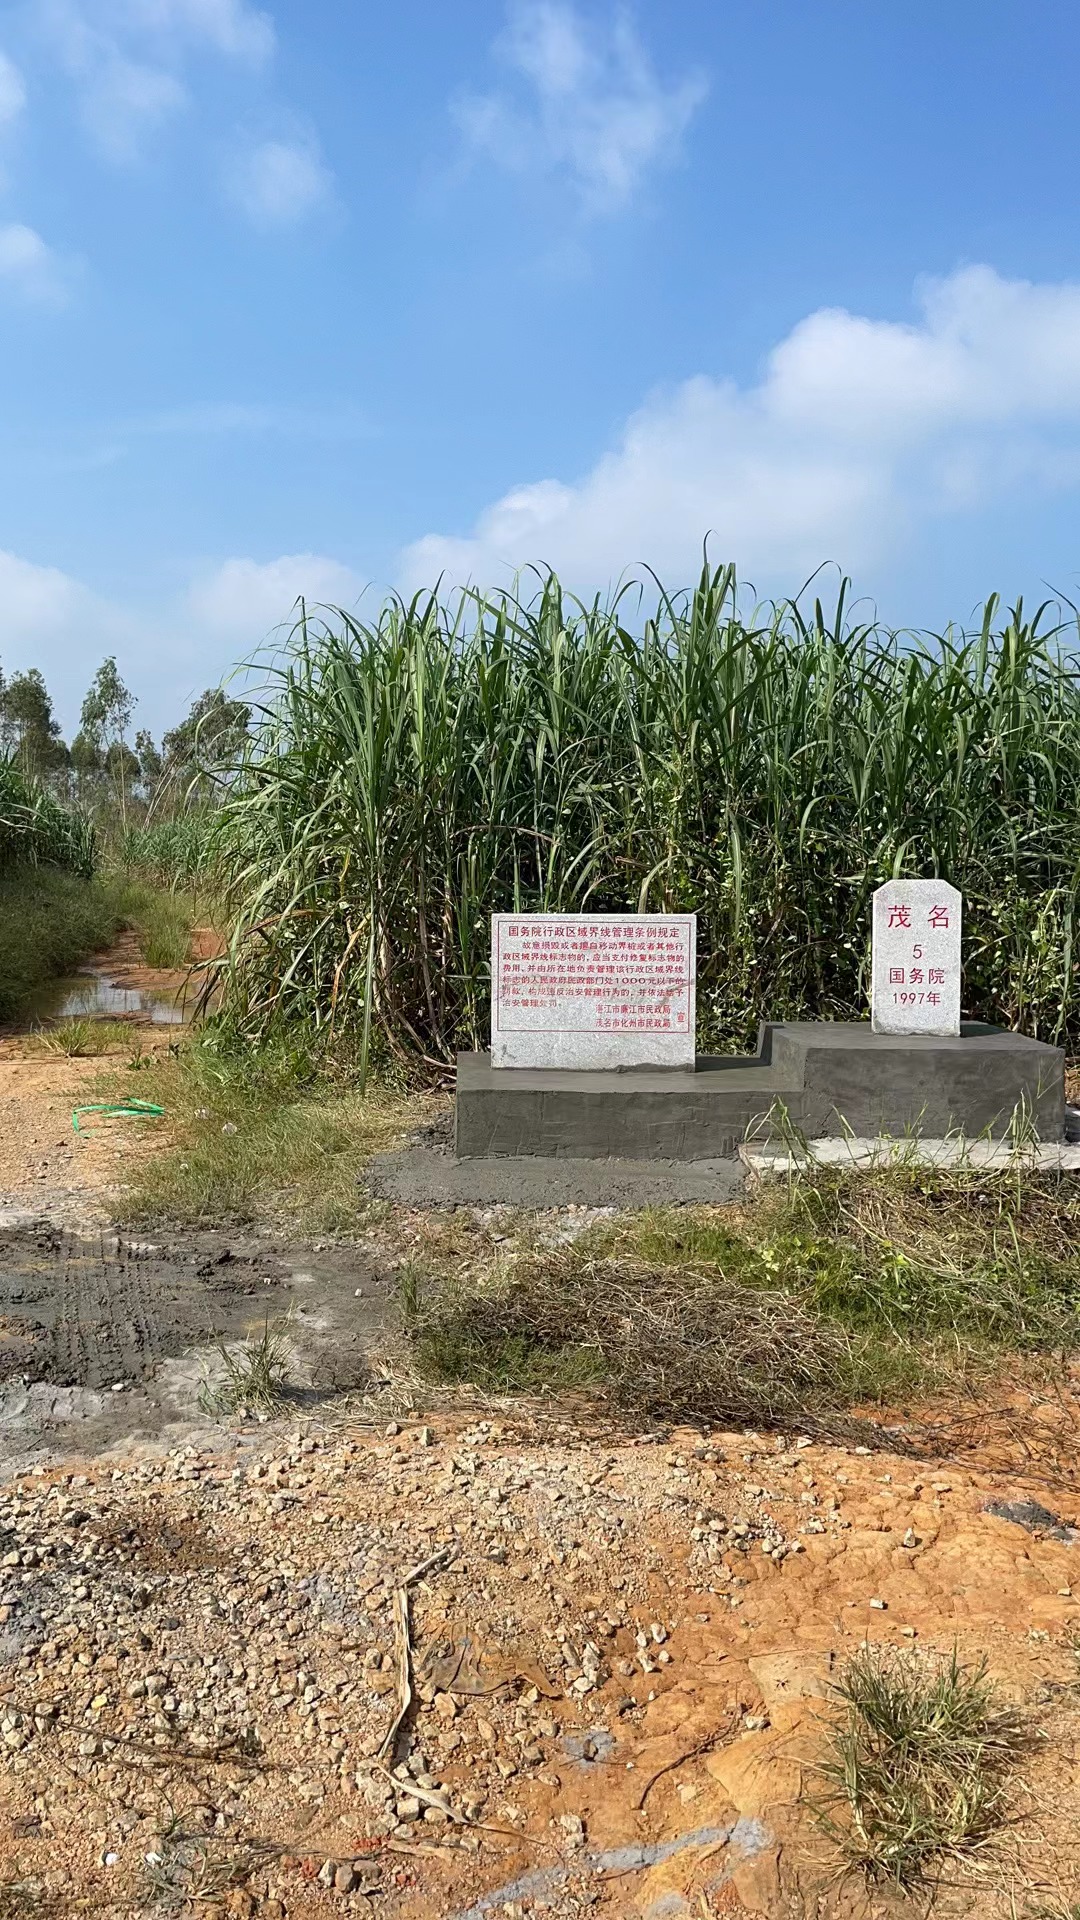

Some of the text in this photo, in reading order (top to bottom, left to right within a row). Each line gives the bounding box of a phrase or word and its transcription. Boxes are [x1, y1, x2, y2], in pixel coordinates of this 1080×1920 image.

[887, 904, 949, 929] 茂名
[508, 925, 680, 938] 国务院行政区域界线管理条例规定
[912, 944, 923, 960] 5
[889, 967, 945, 985] 国务院
[892, 991, 941, 1007] 1997年
[595, 1018, 672, 1028] 茂名市化州市民政局
